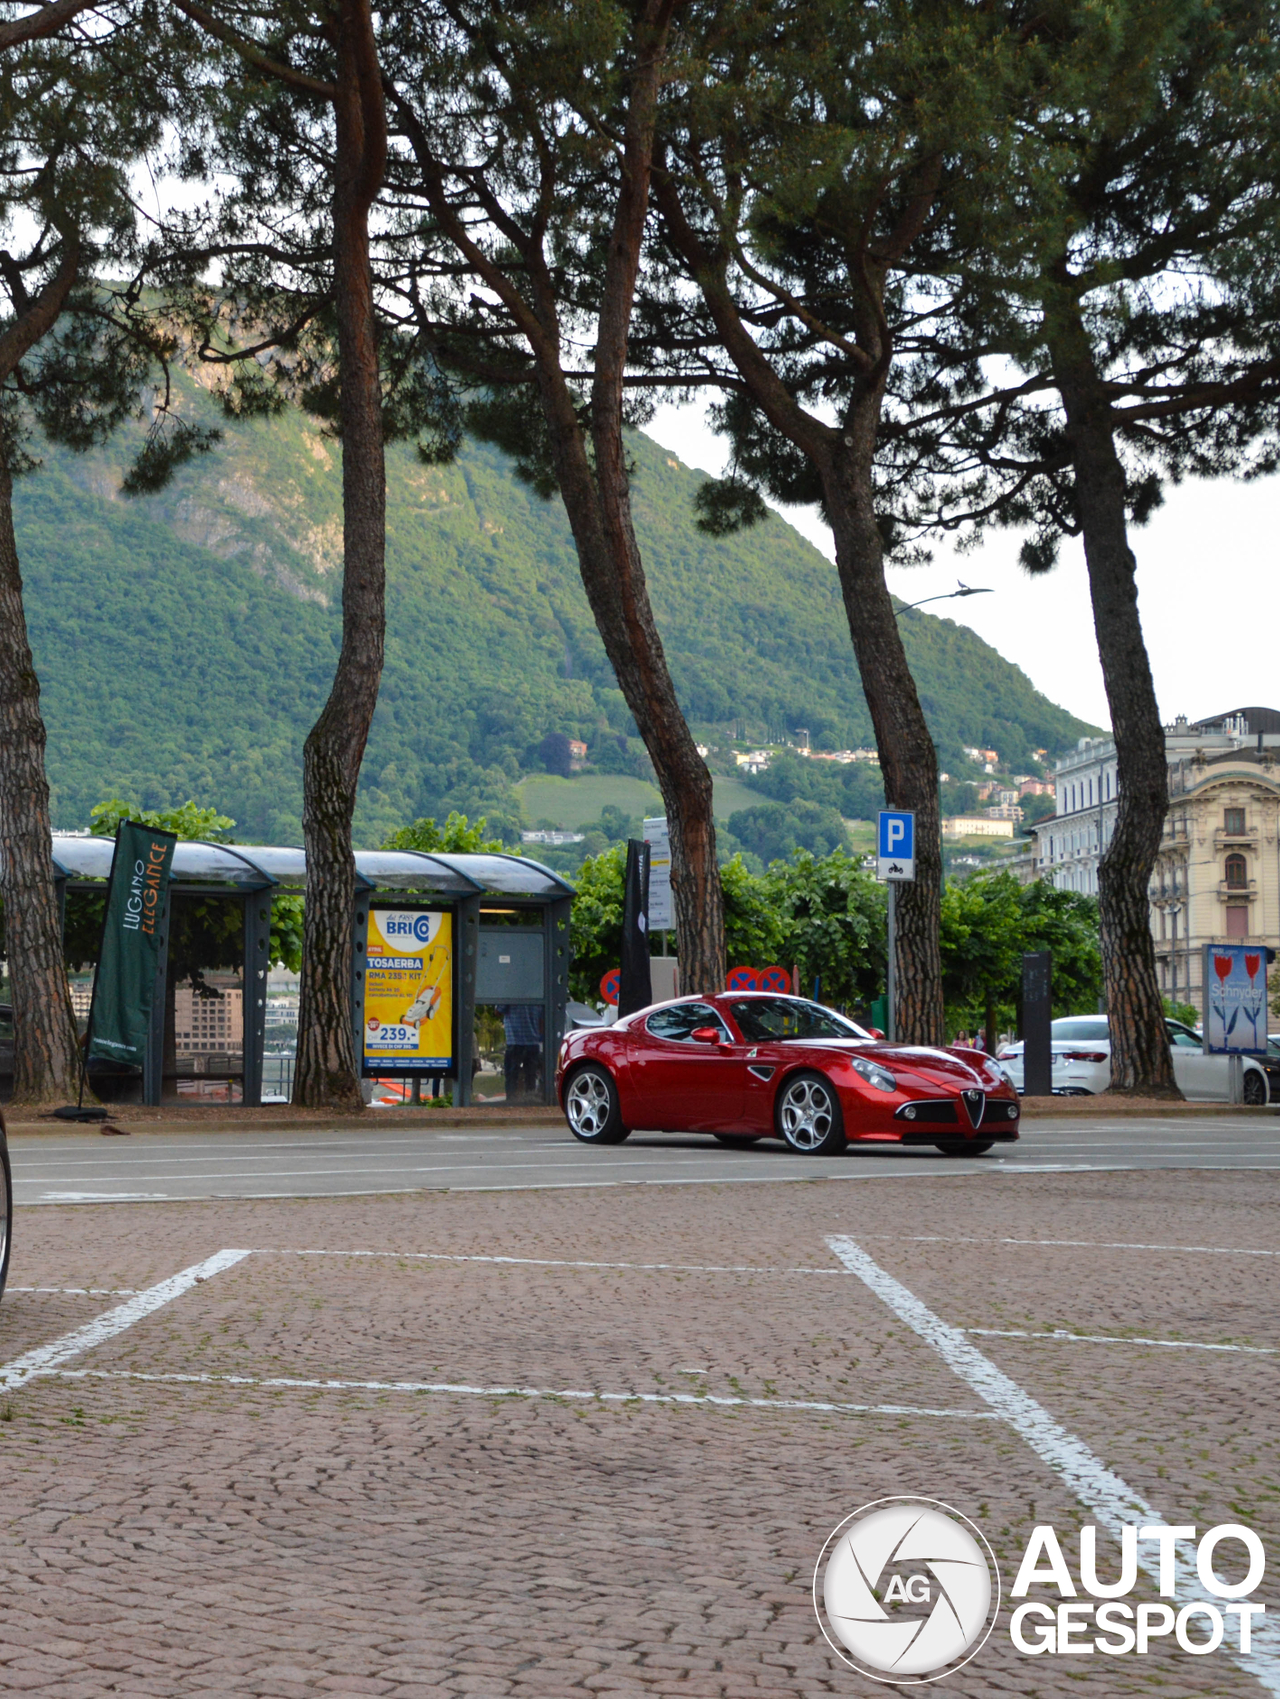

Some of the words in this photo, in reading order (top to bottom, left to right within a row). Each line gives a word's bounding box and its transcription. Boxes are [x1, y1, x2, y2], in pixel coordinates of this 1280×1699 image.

[888, 819, 904, 852] P
[123, 860, 145, 930] LUGANO
[142, 842, 167, 934] ELEGANCE
[386, 915, 429, 942] BRICO
[367, 958, 422, 968] TOSAERBA
[1212, 983, 1263, 1000] Schnyder
[380, 1028, 416, 1041] 239.-
